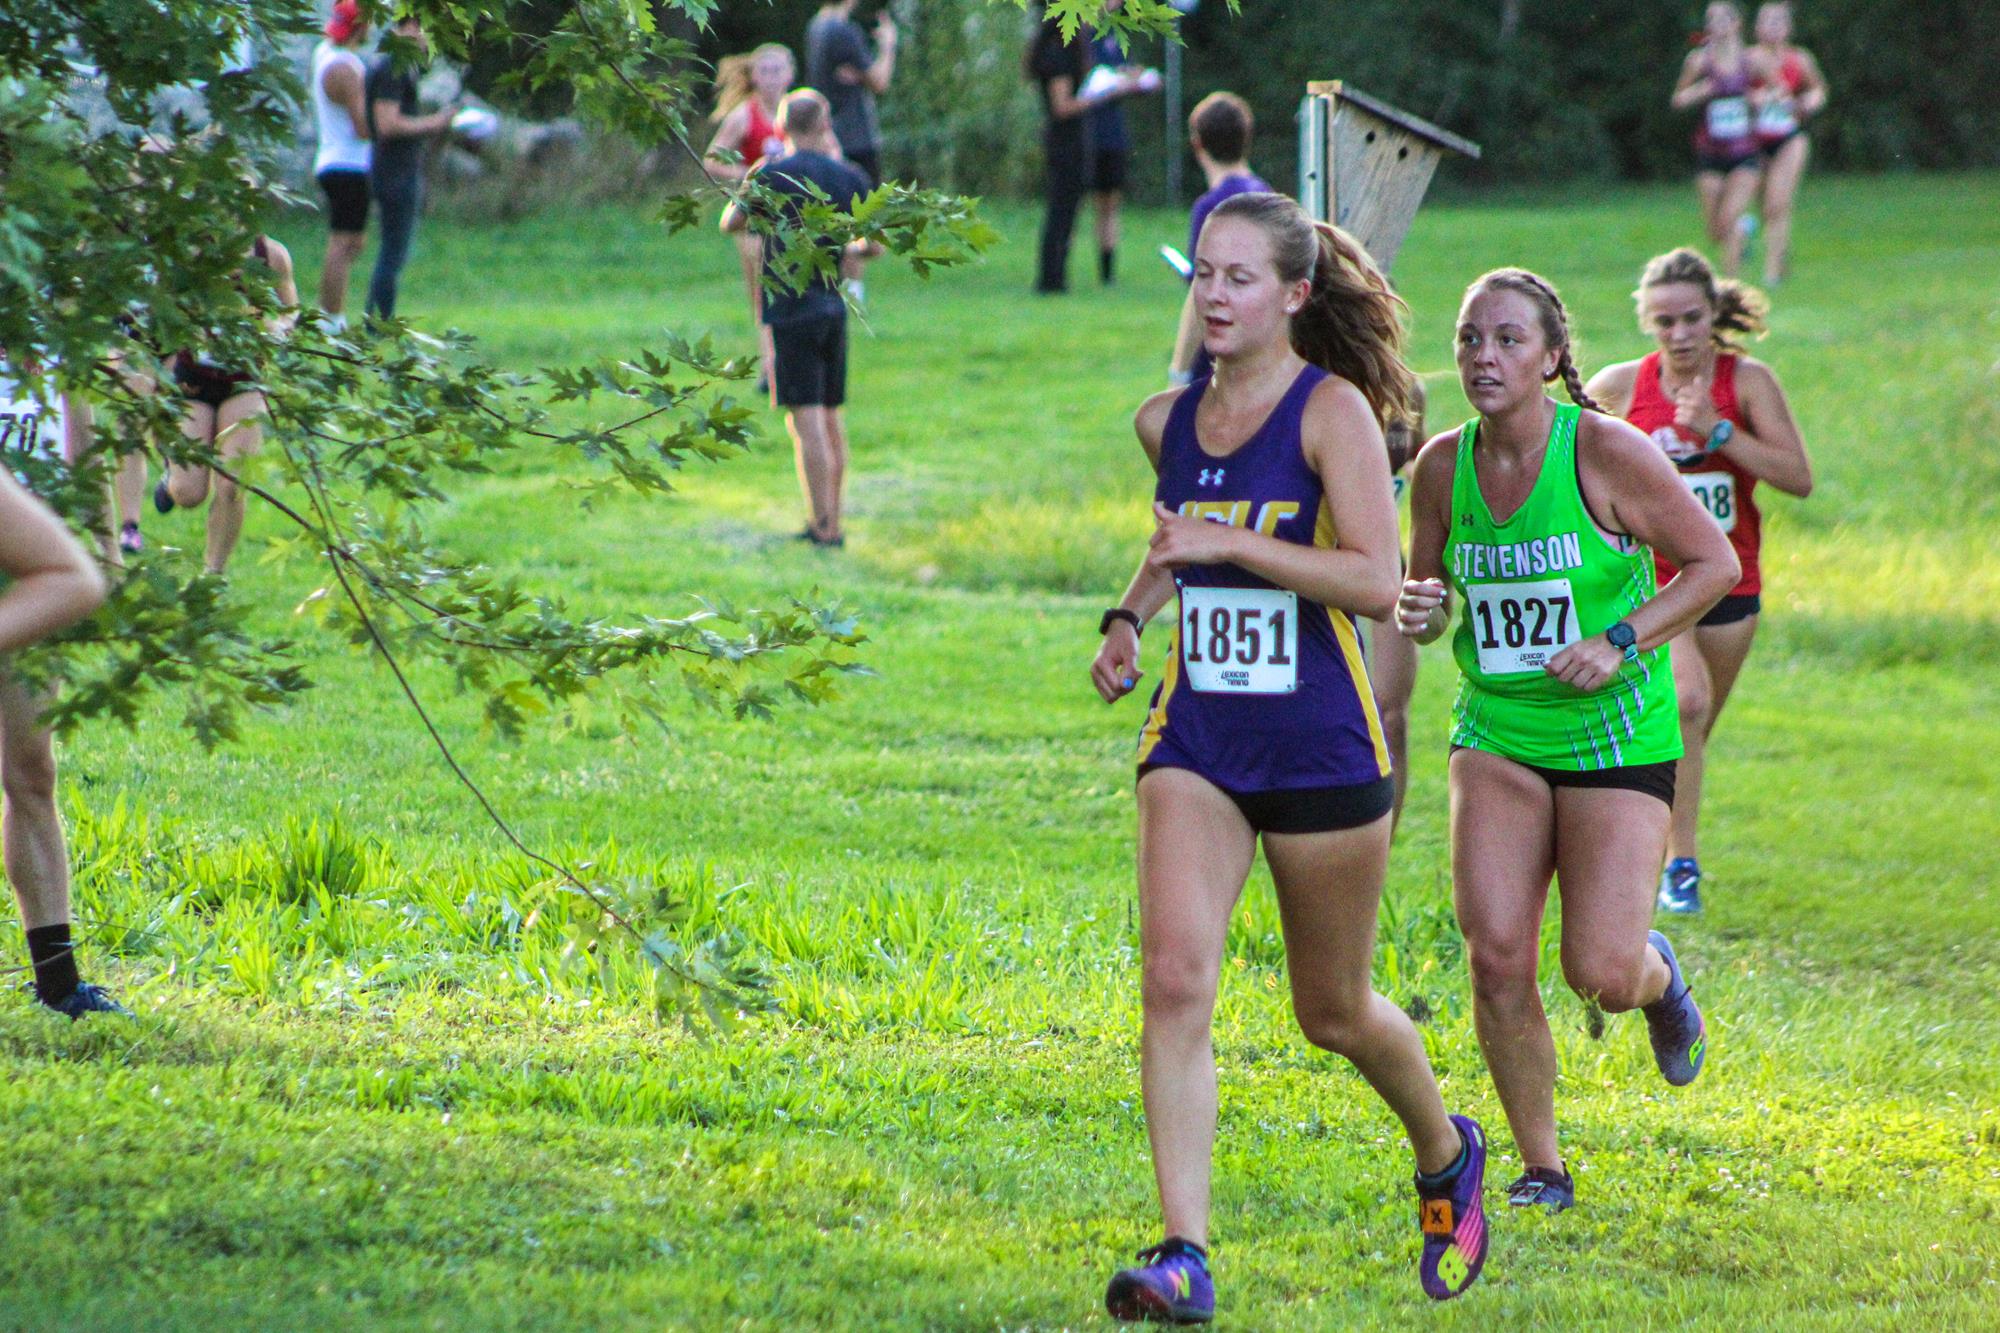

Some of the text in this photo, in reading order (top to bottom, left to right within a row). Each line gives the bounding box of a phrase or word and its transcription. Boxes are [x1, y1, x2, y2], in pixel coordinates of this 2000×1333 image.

[1454, 532, 1583, 578] STEVENSON
[1188, 606, 1290, 665] 1851
[1477, 596, 1571, 649] 1827
